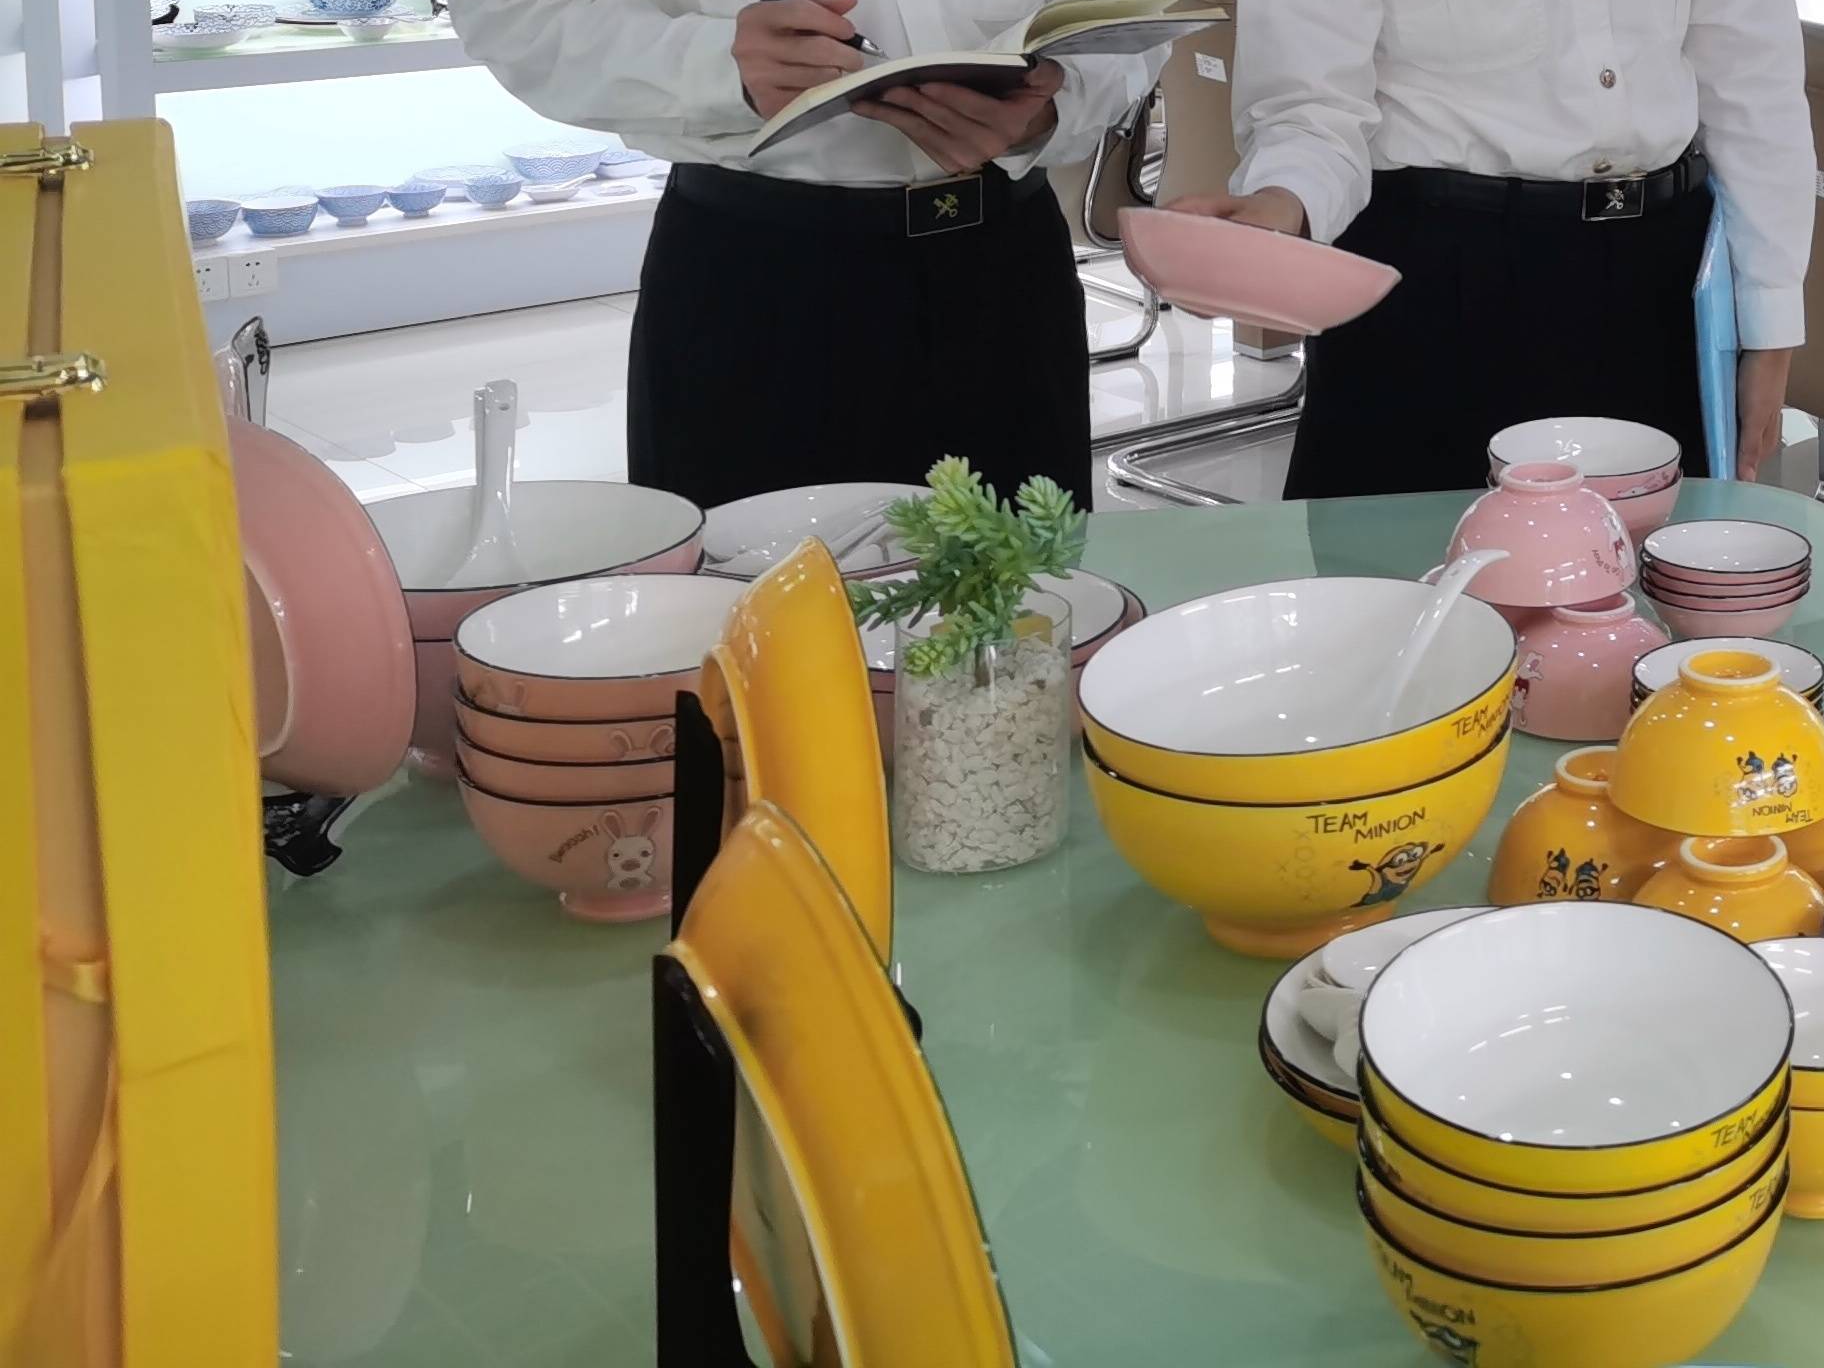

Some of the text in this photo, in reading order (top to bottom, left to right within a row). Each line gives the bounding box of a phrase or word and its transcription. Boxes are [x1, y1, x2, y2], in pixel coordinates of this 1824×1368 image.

[1752, 802, 1793, 817] MINION
[1305, 811, 1369, 834] TEAM
[1354, 806, 1427, 844] MINION
